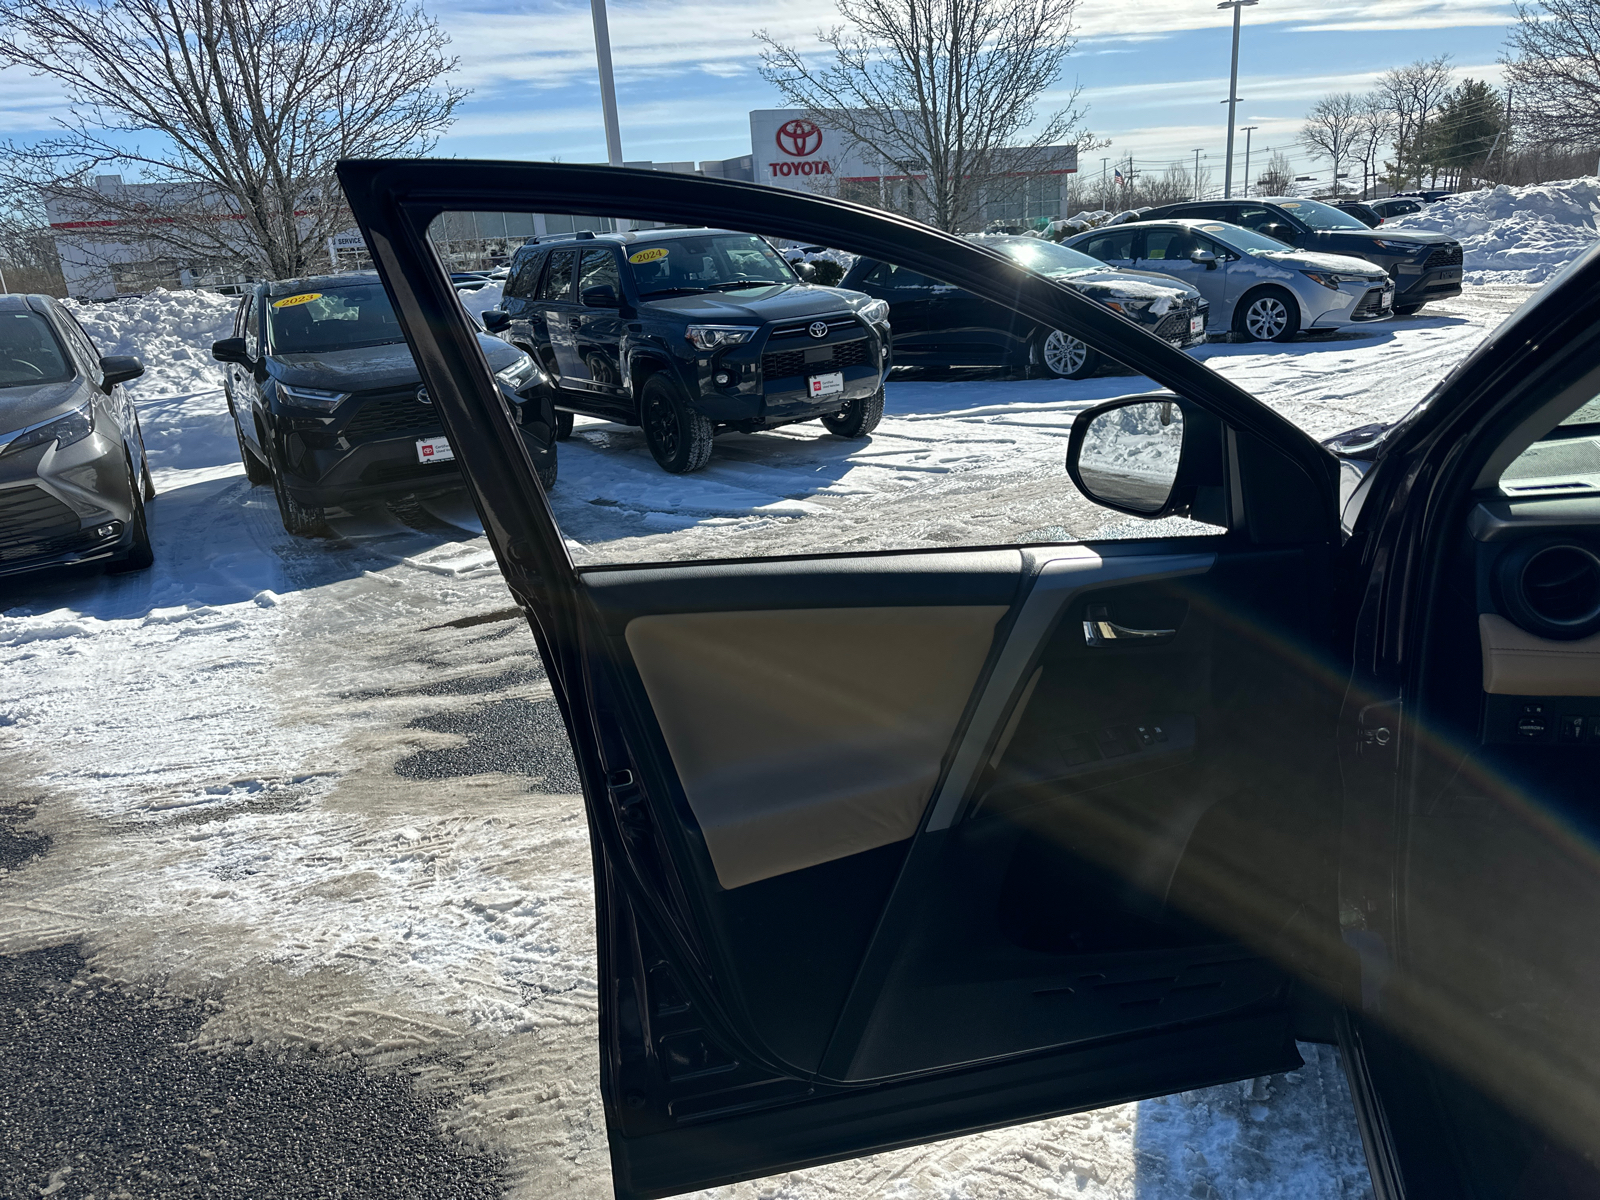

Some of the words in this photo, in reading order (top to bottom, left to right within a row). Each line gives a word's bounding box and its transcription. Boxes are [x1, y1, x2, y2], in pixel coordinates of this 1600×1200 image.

[769, 161, 832, 177] TOYOTA
[636, 249, 662, 262] 2024
[282, 294, 314, 306] 2023
